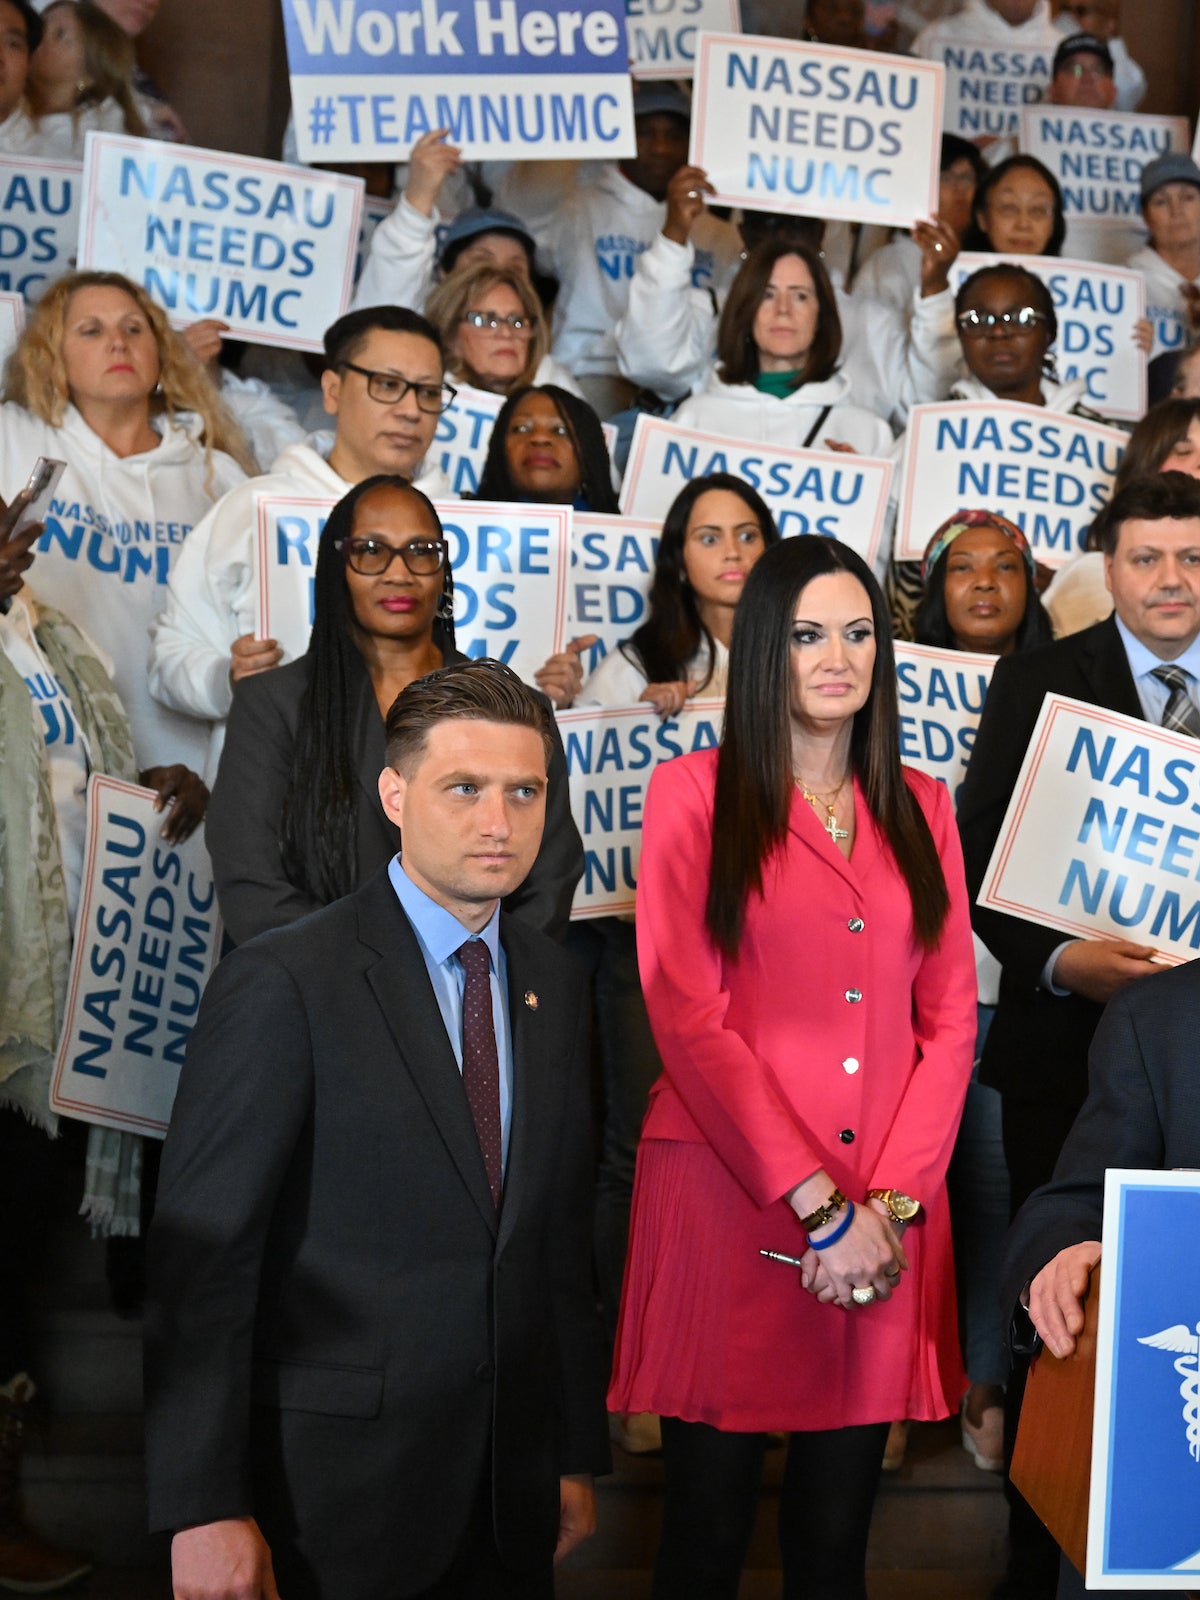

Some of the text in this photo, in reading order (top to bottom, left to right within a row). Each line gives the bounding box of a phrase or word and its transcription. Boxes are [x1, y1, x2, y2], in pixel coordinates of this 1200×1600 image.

[292, 0, 620, 56] Work Here
[726, 53, 918, 111] NASSAU
[942, 47, 1049, 76] NASSA
[308, 93, 621, 146] #TEAMNUMC
[960, 80, 1043, 105] NEED
[748, 104, 903, 157] NEEDS
[1040, 117, 1172, 153] NASSAU
[119, 157, 336, 230] NASSAU
[746, 152, 893, 206] NUMC
[1060, 153, 1145, 184] NEED
[1062, 186, 1142, 216] NUM
[145, 214, 315, 278] NEEDS
[144, 267, 303, 329] NUMC
[661, 441, 865, 506] NASSAU
[936, 416, 1124, 476] NASSAU
[957, 462, 1111, 515] NEEDS
[37, 516, 171, 585] NUM
[277, 516, 550, 575] RORE
[897, 661, 989, 715] SAU
[566, 720, 721, 777] NASSA
[71, 812, 147, 1080] NASSAU
[122, 847, 181, 1059] NEEDS
[162, 871, 216, 1066] NUMC
